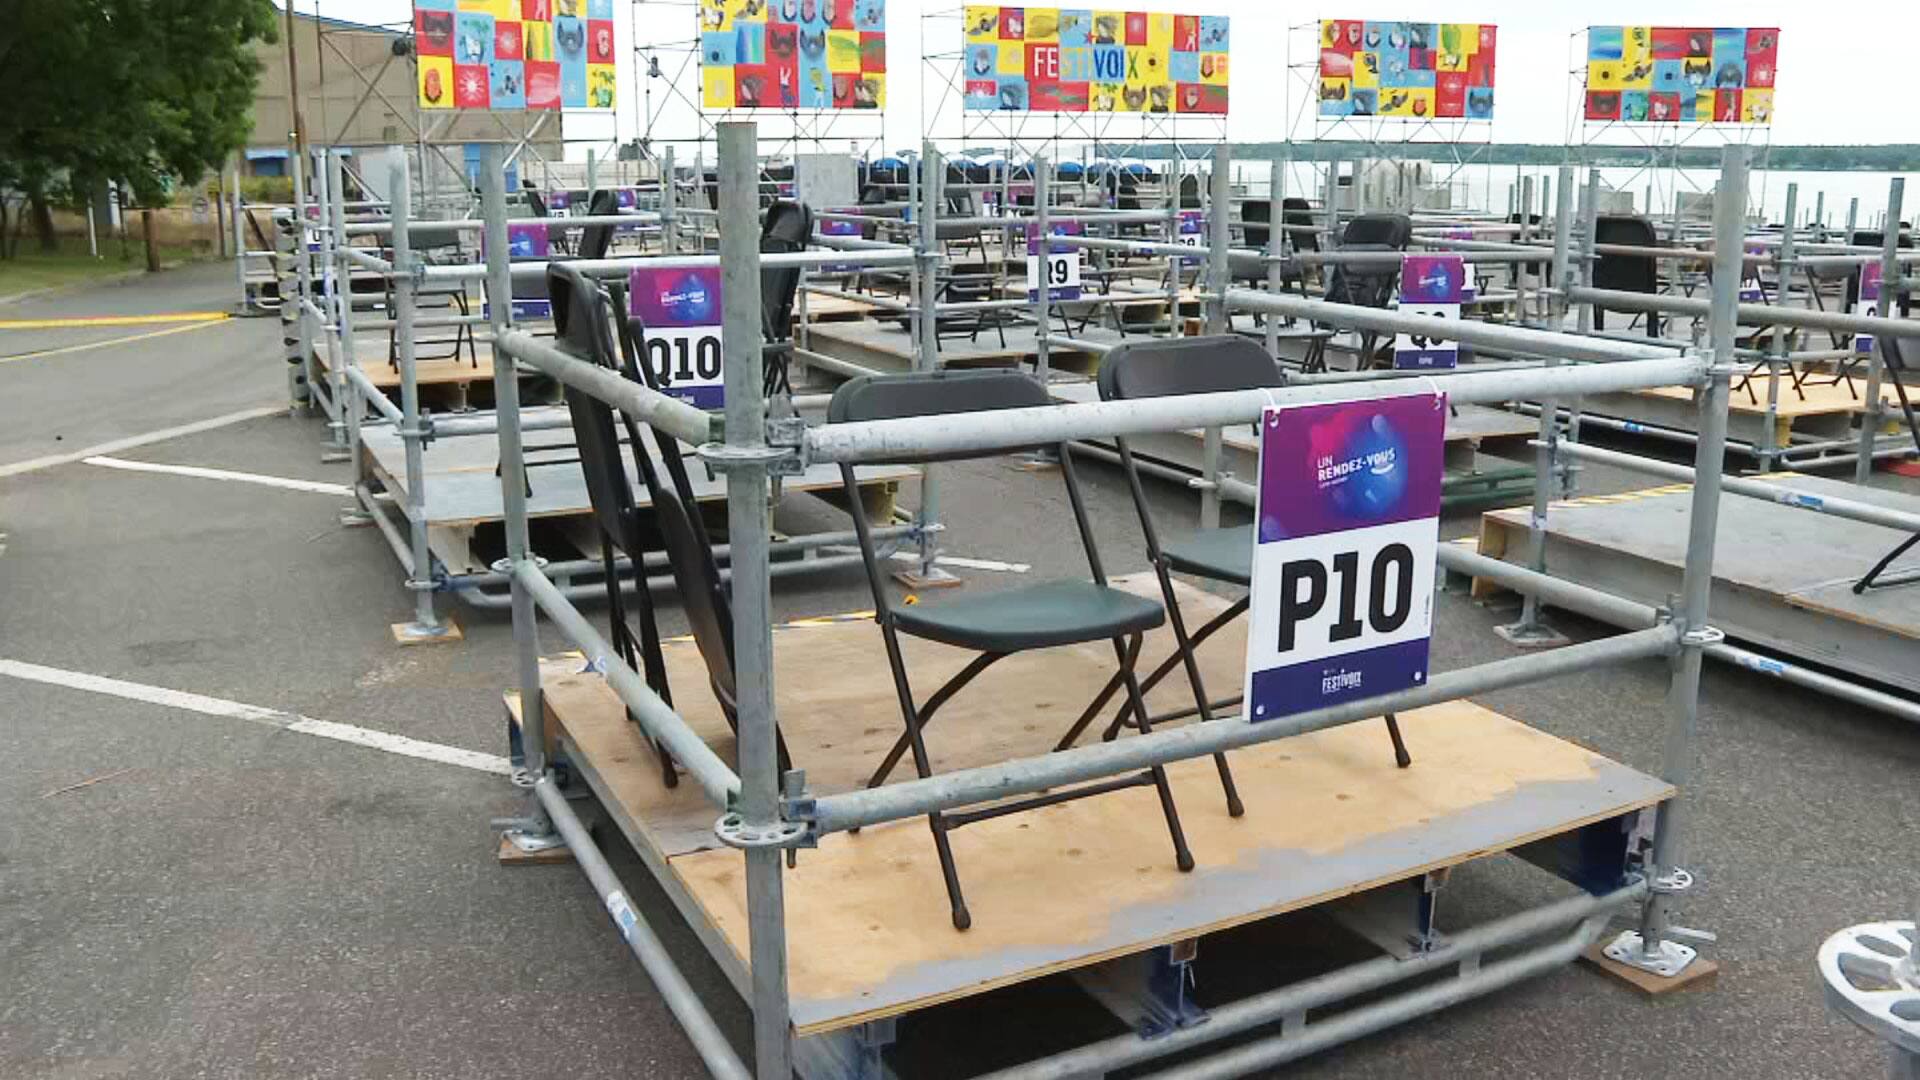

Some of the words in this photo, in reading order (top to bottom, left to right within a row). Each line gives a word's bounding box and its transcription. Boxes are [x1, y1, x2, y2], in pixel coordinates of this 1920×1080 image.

[1034, 46, 1139, 79] FESTIVOIX
[646, 335, 721, 387] Q10
[1317, 455, 1333, 469] UN
[1318, 447, 1396, 481] RENDEZ-VOUS
[1278, 542, 1414, 652] P10
